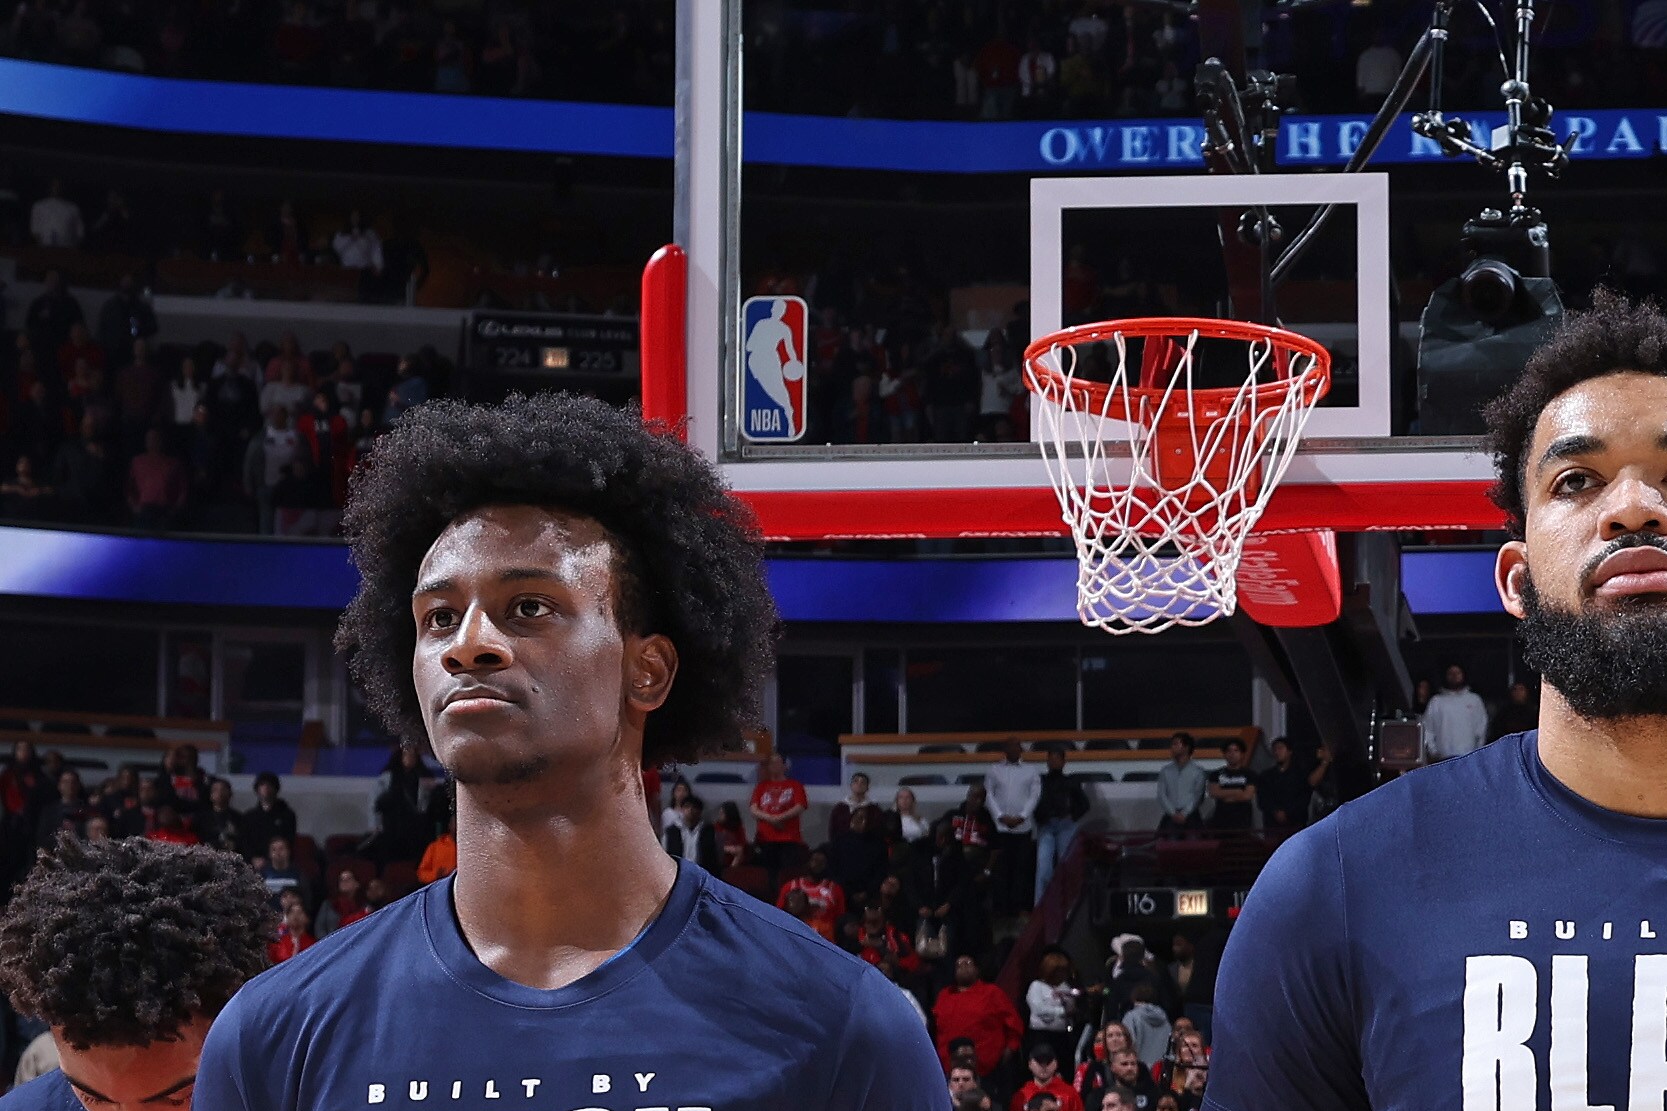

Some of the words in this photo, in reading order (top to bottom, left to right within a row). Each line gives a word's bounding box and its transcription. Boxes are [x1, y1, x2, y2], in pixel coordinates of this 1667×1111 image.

[750, 409, 781, 432] NBA
[1127, 893, 1156, 914] 116
[1178, 894, 1207, 912] EXIT
[368, 1073, 541, 1104] BUILT
[592, 1072, 656, 1094] BY
